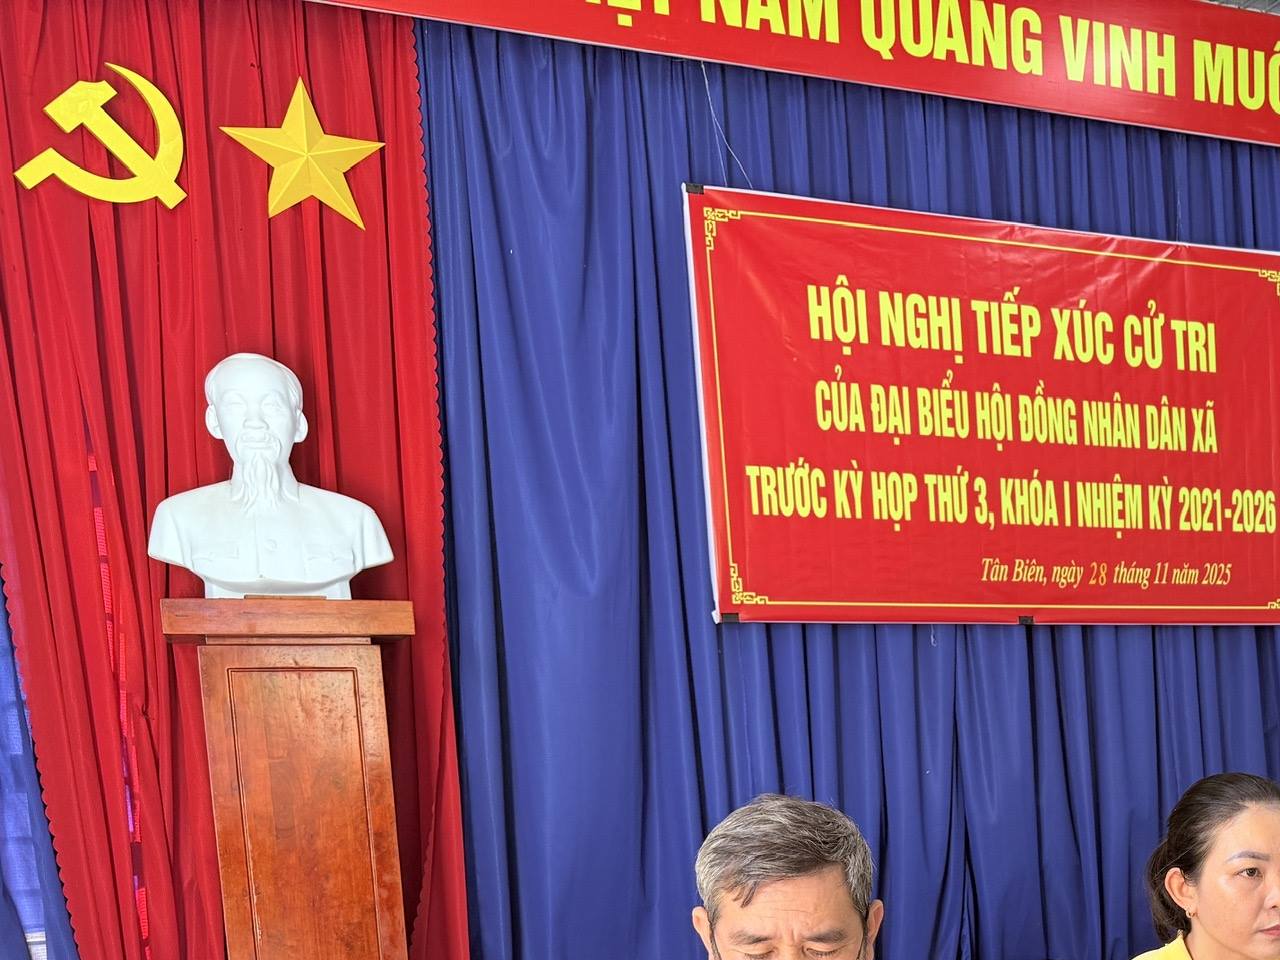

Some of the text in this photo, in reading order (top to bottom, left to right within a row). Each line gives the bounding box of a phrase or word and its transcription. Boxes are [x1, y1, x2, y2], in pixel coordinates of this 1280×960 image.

[861, 0, 1043, 76] QUANG
[1058, 15, 1176, 97] VINH
[807, 275, 1217, 373] HỘI NGHỊ TIẾP XÚC CỬ TRI
[815, 364, 1218, 454] CỦA ĐẠI BIỂU HỘI ĐỒNG NHÂN DÂN XÃ
[745, 457, 1277, 539] TRƯỚC KỲ HỌP THỨ 3, KHÓA I NHIỆM KỲ 2021-2026
[981, 557, 1232, 590] Tân Biên, ngày 28 tháng 11 năm 2025
